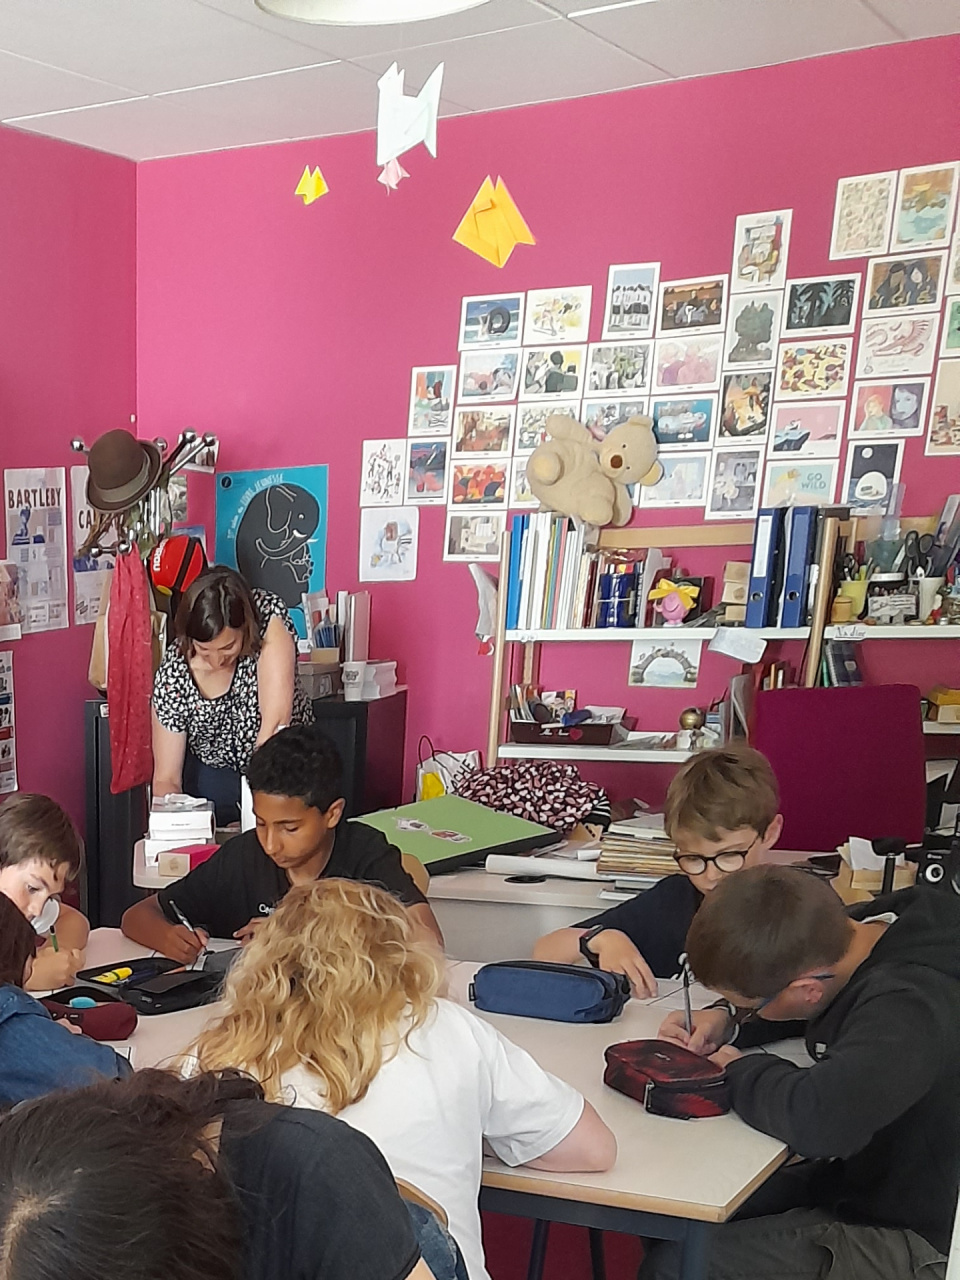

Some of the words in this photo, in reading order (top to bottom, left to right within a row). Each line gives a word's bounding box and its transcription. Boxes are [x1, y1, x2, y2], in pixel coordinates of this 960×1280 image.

[807, 472, 823, 481] GO
[801, 481, 827, 490] WILD
[8, 487, 61, 509] BARTLEBY
